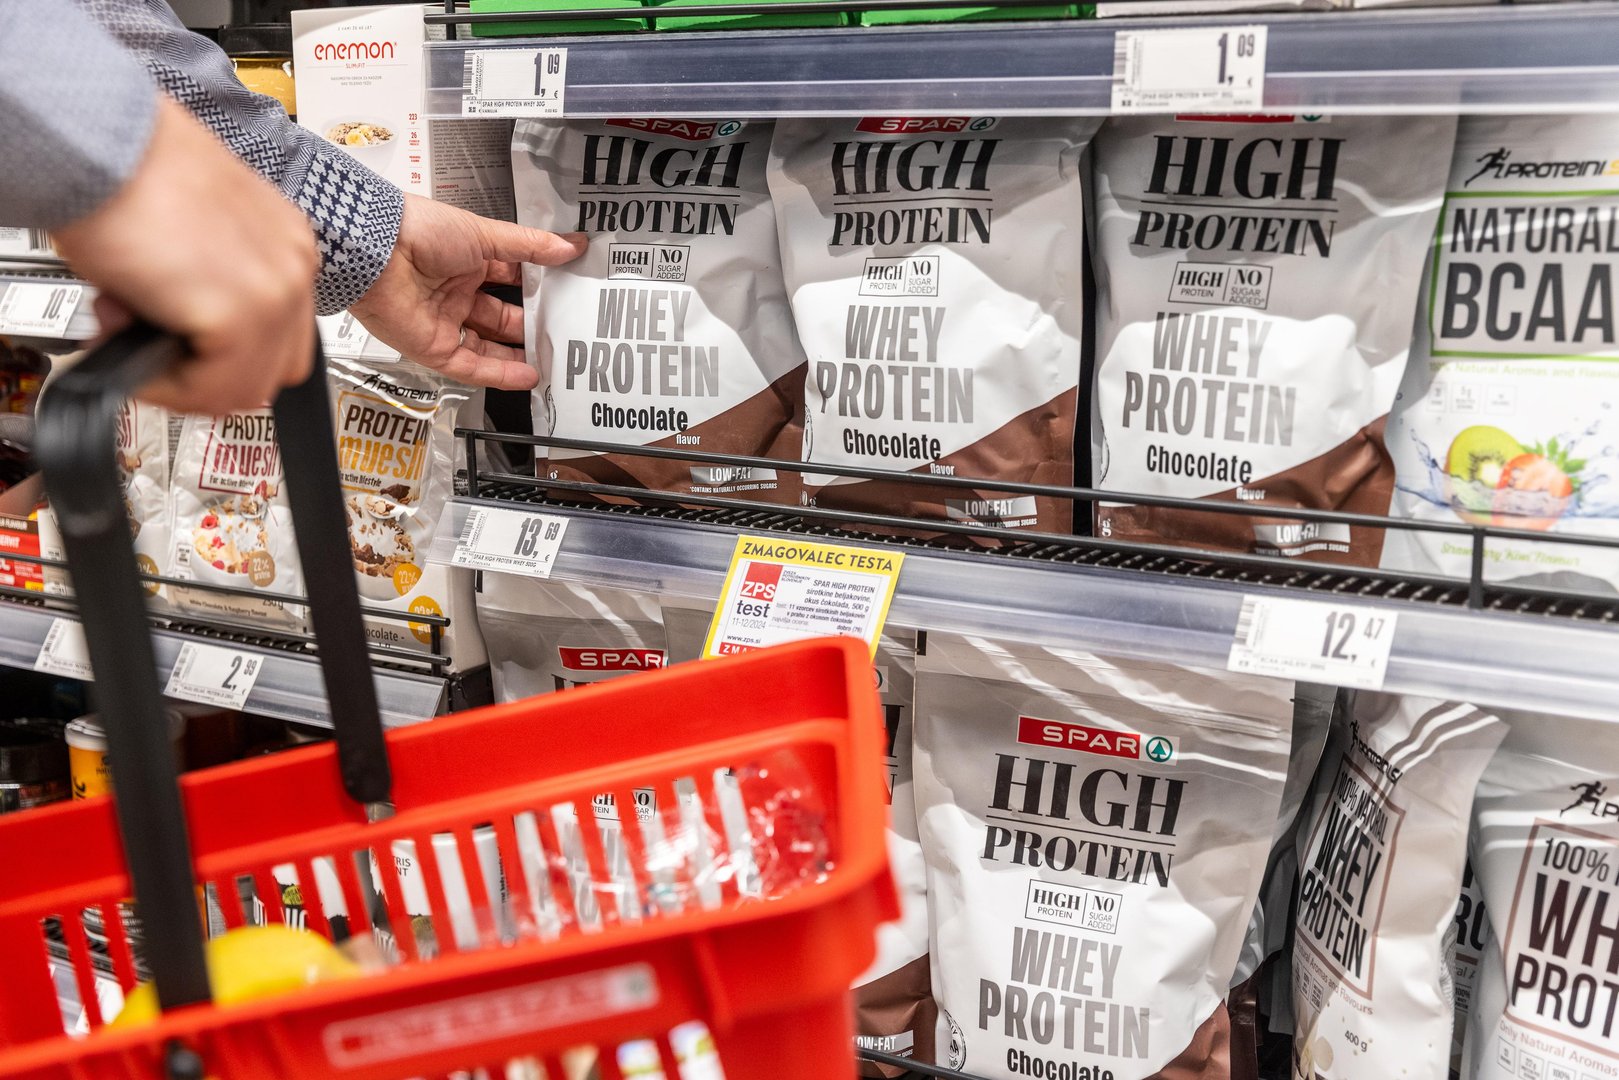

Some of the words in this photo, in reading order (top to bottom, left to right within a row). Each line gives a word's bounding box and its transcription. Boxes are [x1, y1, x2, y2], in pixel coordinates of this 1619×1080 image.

[314, 41, 394, 60] enemon
[629, 118, 714, 138] SPAR
[879, 118, 965, 131] SPAR
[579, 134, 750, 188] HIGH
[831, 138, 1003, 196] HIGH
[1143, 135, 1347, 201] HIGH
[576, 200, 740, 235] PROTEIN
[829, 207, 993, 246] PROTEIN
[1130, 210, 1338, 258] PROTEIN
[1450, 207, 1619, 253] NATURAL
[612, 250, 650, 266] HIGH
[659, 249, 683, 264] NO
[615, 265, 643, 274] PROTEIN
[657, 264, 681, 273] SUGAR
[866, 265, 903, 280] HIGH
[911, 260, 932, 276] NO
[1177, 270, 1224, 287] HIGH
[1236, 269, 1263, 286] NO
[869, 282, 898, 291] PROTEIN
[908, 278, 932, 286] SUGAR
[1180, 288, 1215, 297] PROTEIN
[1230, 287, 1262, 297] SUGAR
[1440, 262, 1615, 343] BCAA
[596, 288, 692, 342] WHEY
[845, 305, 946, 363] WHEY
[1153, 311, 1273, 378] WHEY
[565, 339, 719, 397] PROTEIN
[816, 360, 974, 424] PROTEIN
[591, 402, 688, 431] Chocolate
[1122, 370, 1297, 447] PROTEIN
[221, 414, 277, 442] PROTE
[344, 404, 431, 446] PROTEIN
[676, 434, 701, 445] flavor
[843, 428, 941, 461] Chocolate
[709, 466, 752, 481] LOW-FAT
[930, 462, 955, 475] flavor
[1147, 444, 1252, 484] Chocolate
[1236, 487, 1266, 500] flavor
[964, 500, 1014, 516] LOW-FAT
[544, 522, 561, 541] 69
[742, 542, 847, 566] ZMAGOVALEC
[850, 555, 893, 571] TESTA
[741, 581, 776, 599] ZPS
[806, 588, 833, 597] sirotkine
[813, 579, 830, 587] SPAR
[831, 581, 847, 590] HIGH
[848, 583, 876, 593] PROTEIN
[736, 600, 770, 618] test
[732, 617, 767, 628] 11-12/2024
[1363, 617, 1385, 640] 47
[364, 627, 399, 642] ocolate
[579, 652, 661, 668] SPAR
[1042, 725, 1138, 754] SPAR
[987, 753, 1189, 836] HIGH
[980, 825, 1175, 888] PROTEIN
[1314, 801, 1383, 919] WHEY
[1543, 838, 1609, 883] 100%
[1033, 889, 1081, 911] HIGH
[1093, 895, 1115, 912] NO
[1037, 906, 1073, 919] PROTEIN
[1088, 912, 1113, 923] SUGAR
[1299, 869, 1368, 982] PROTEIN
[1011, 926, 1123, 999] WHEY
[978, 978, 1150, 1060] PROTEIN
[1344, 1030, 1359, 1047] 400
[1361, 1041, 1368, 1052] g
[1520, 1033, 1565, 1058] Natural
